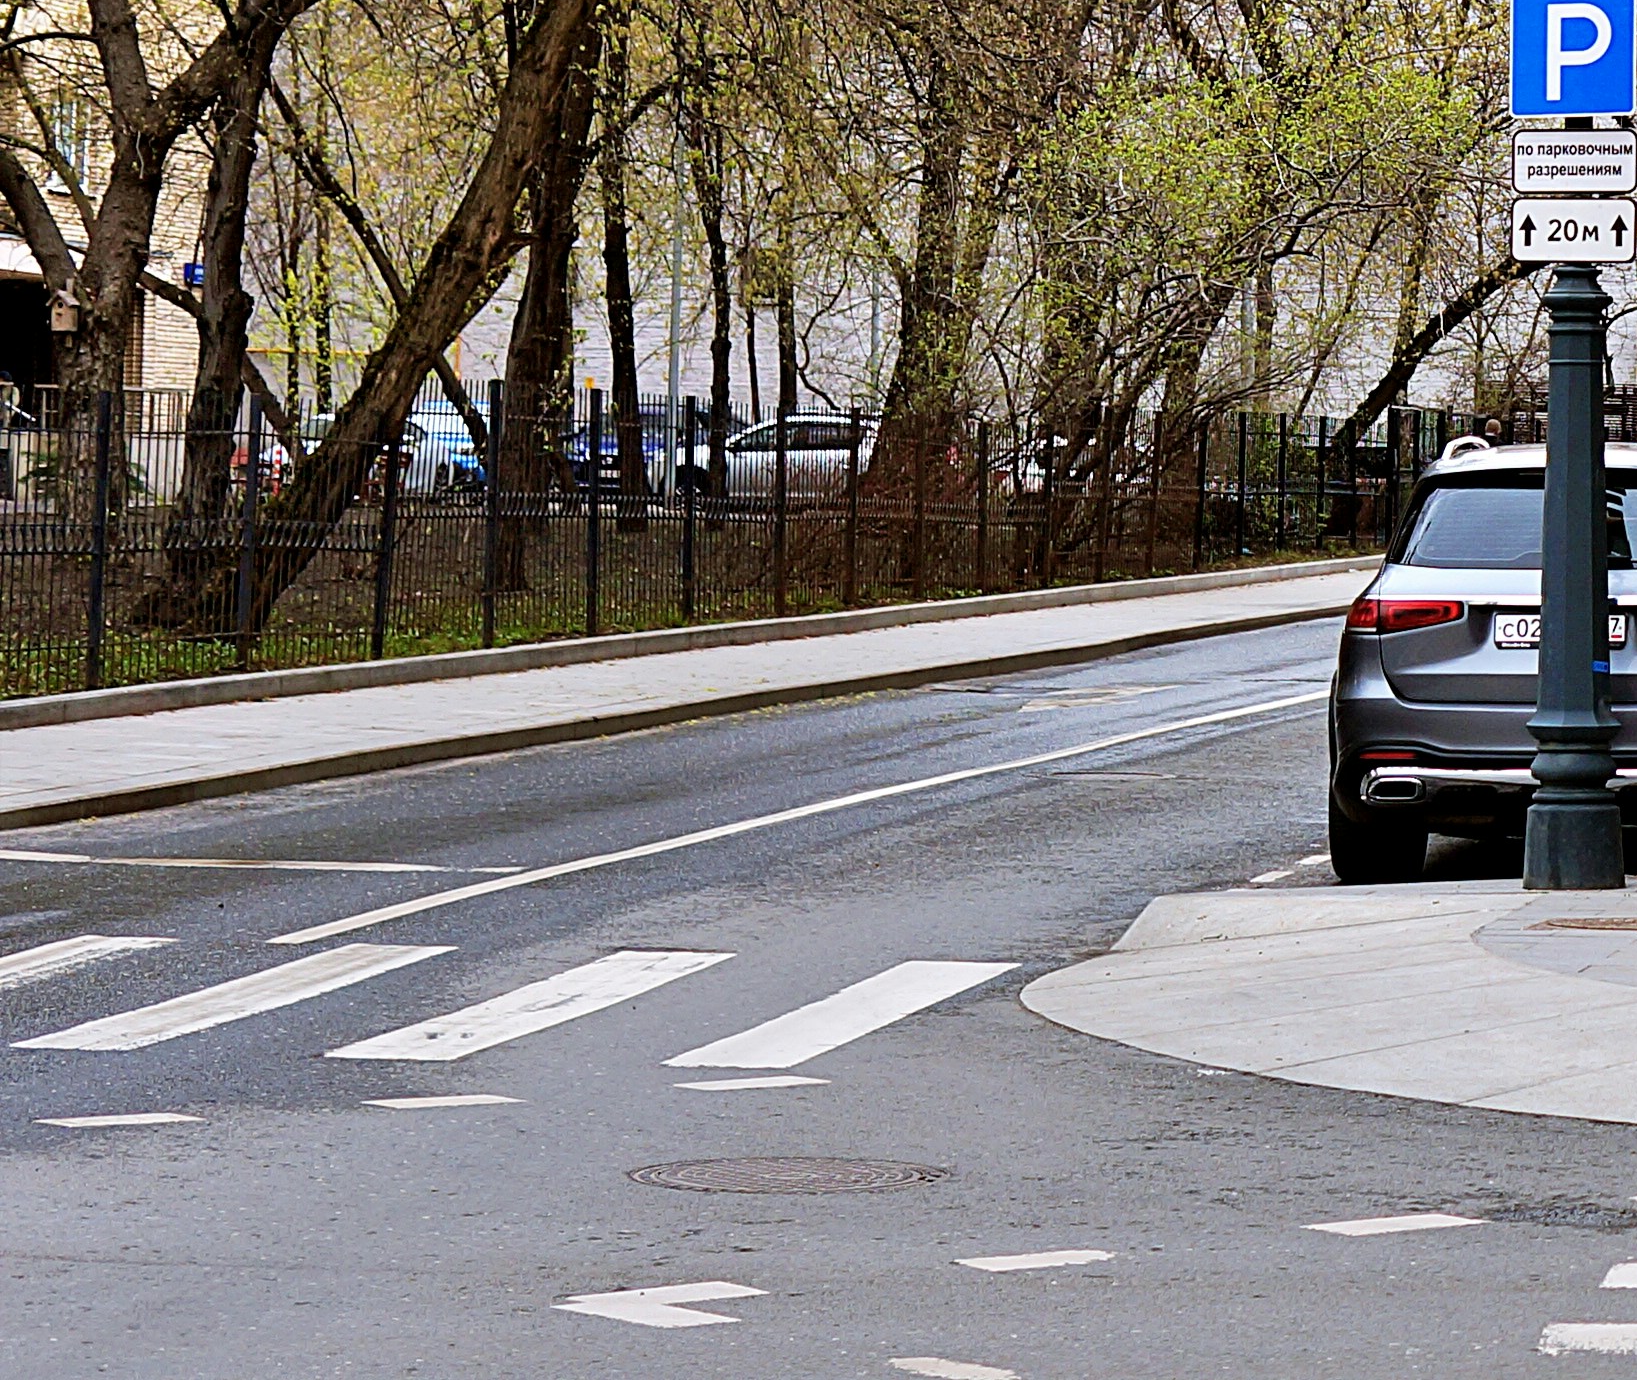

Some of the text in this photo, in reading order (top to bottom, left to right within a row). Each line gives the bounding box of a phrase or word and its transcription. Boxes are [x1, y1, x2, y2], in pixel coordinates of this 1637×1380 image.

[1545, 3, 1612, 102] P
[1517, 144, 1634, 158] по парковочным
[1527, 164, 1623, 180] разрешениям
